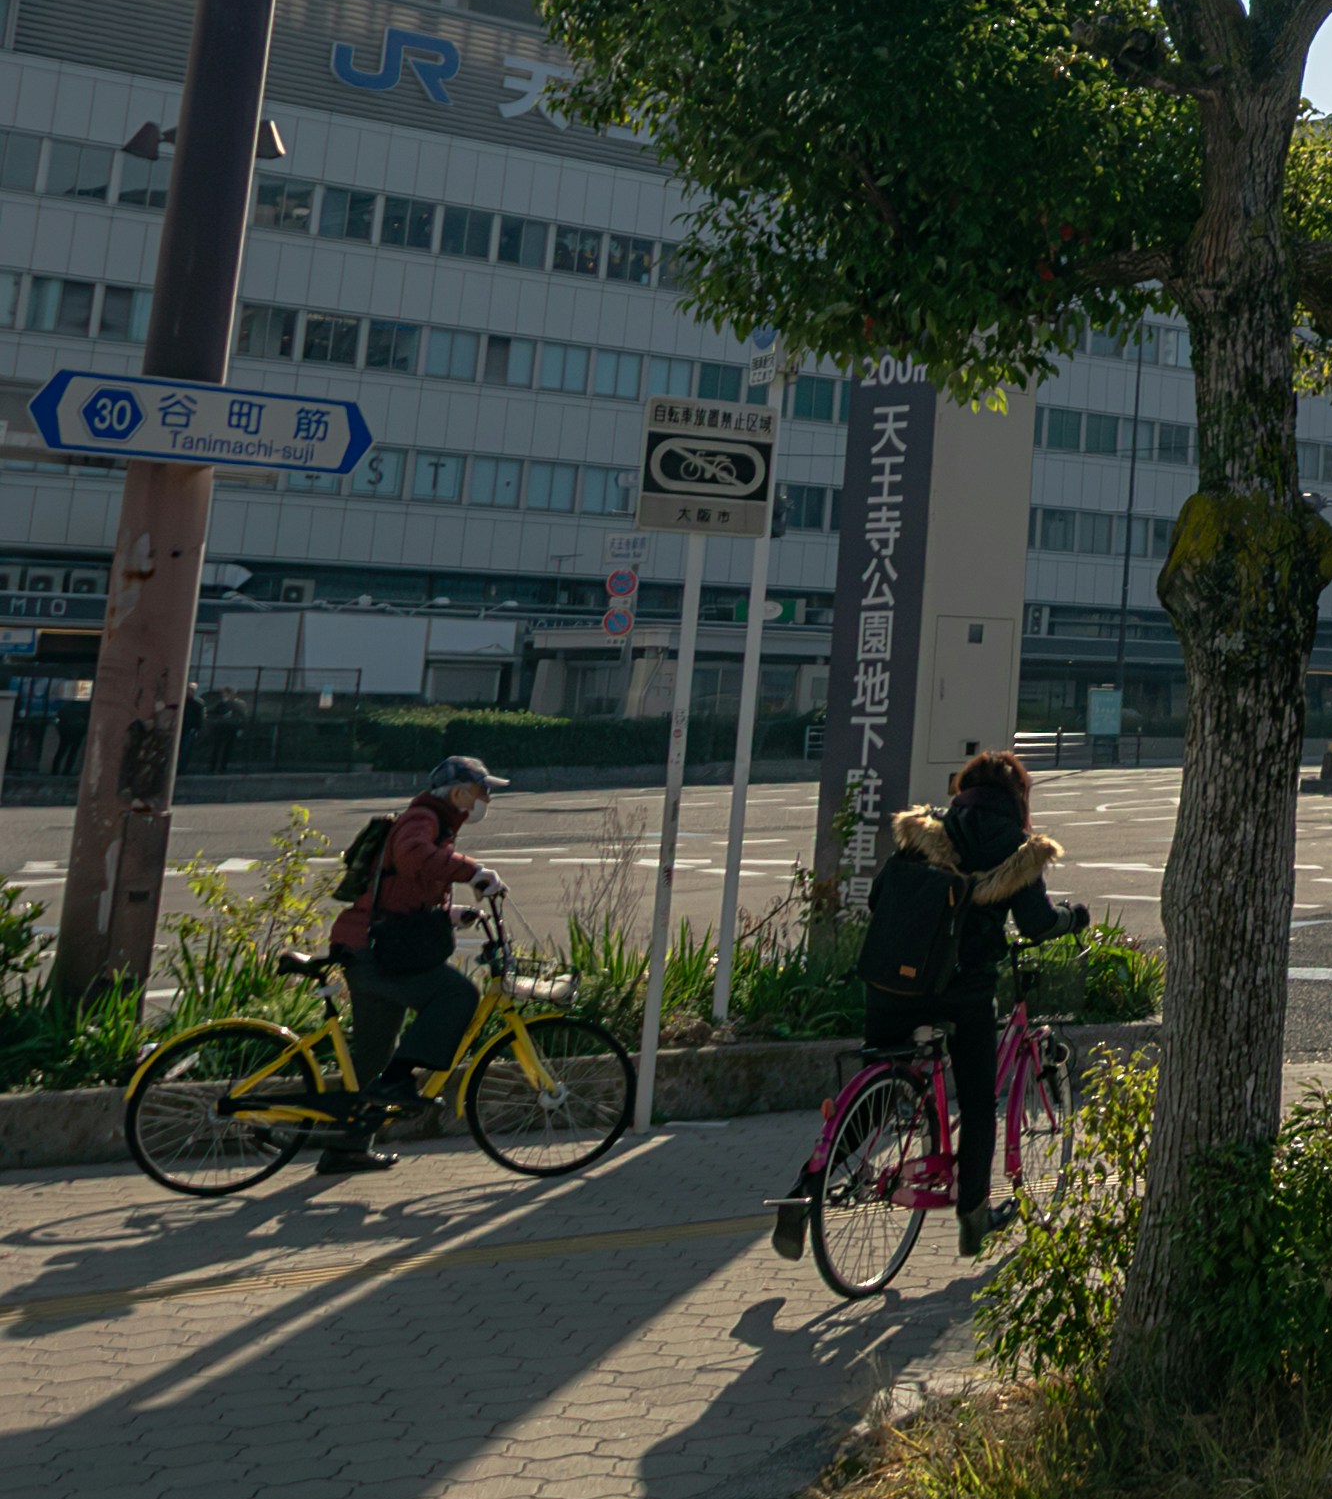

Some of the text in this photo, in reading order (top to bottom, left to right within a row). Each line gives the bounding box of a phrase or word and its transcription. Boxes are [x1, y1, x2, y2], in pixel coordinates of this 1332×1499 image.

[330, 26, 462, 107] JR
[94, 392, 331, 442] 30 谷町筋
[653, 404, 772, 434] 自転車放置禁止区域
[169, 429, 315, 465] Tanimachi-suji
[676, 507, 733, 524] 大阪市
[9, 596, 67, 616] MIO
